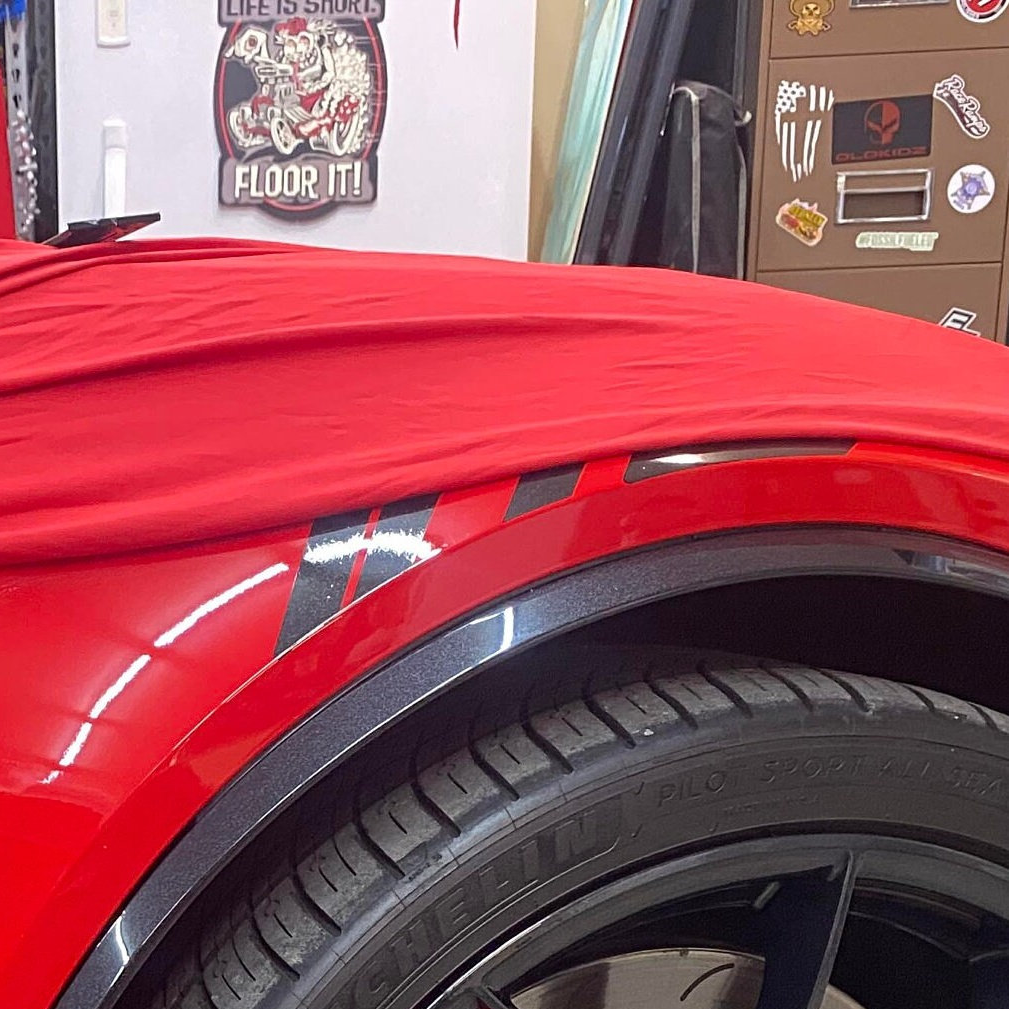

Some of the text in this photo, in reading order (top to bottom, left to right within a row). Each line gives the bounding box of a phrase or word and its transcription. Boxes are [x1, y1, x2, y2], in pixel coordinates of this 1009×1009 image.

[227, 0, 269, 15] LIFE
[277, 0, 297, 14] IS
[942, 77, 967, 103] Race
[234, 161, 362, 199] FLOOR IT!
